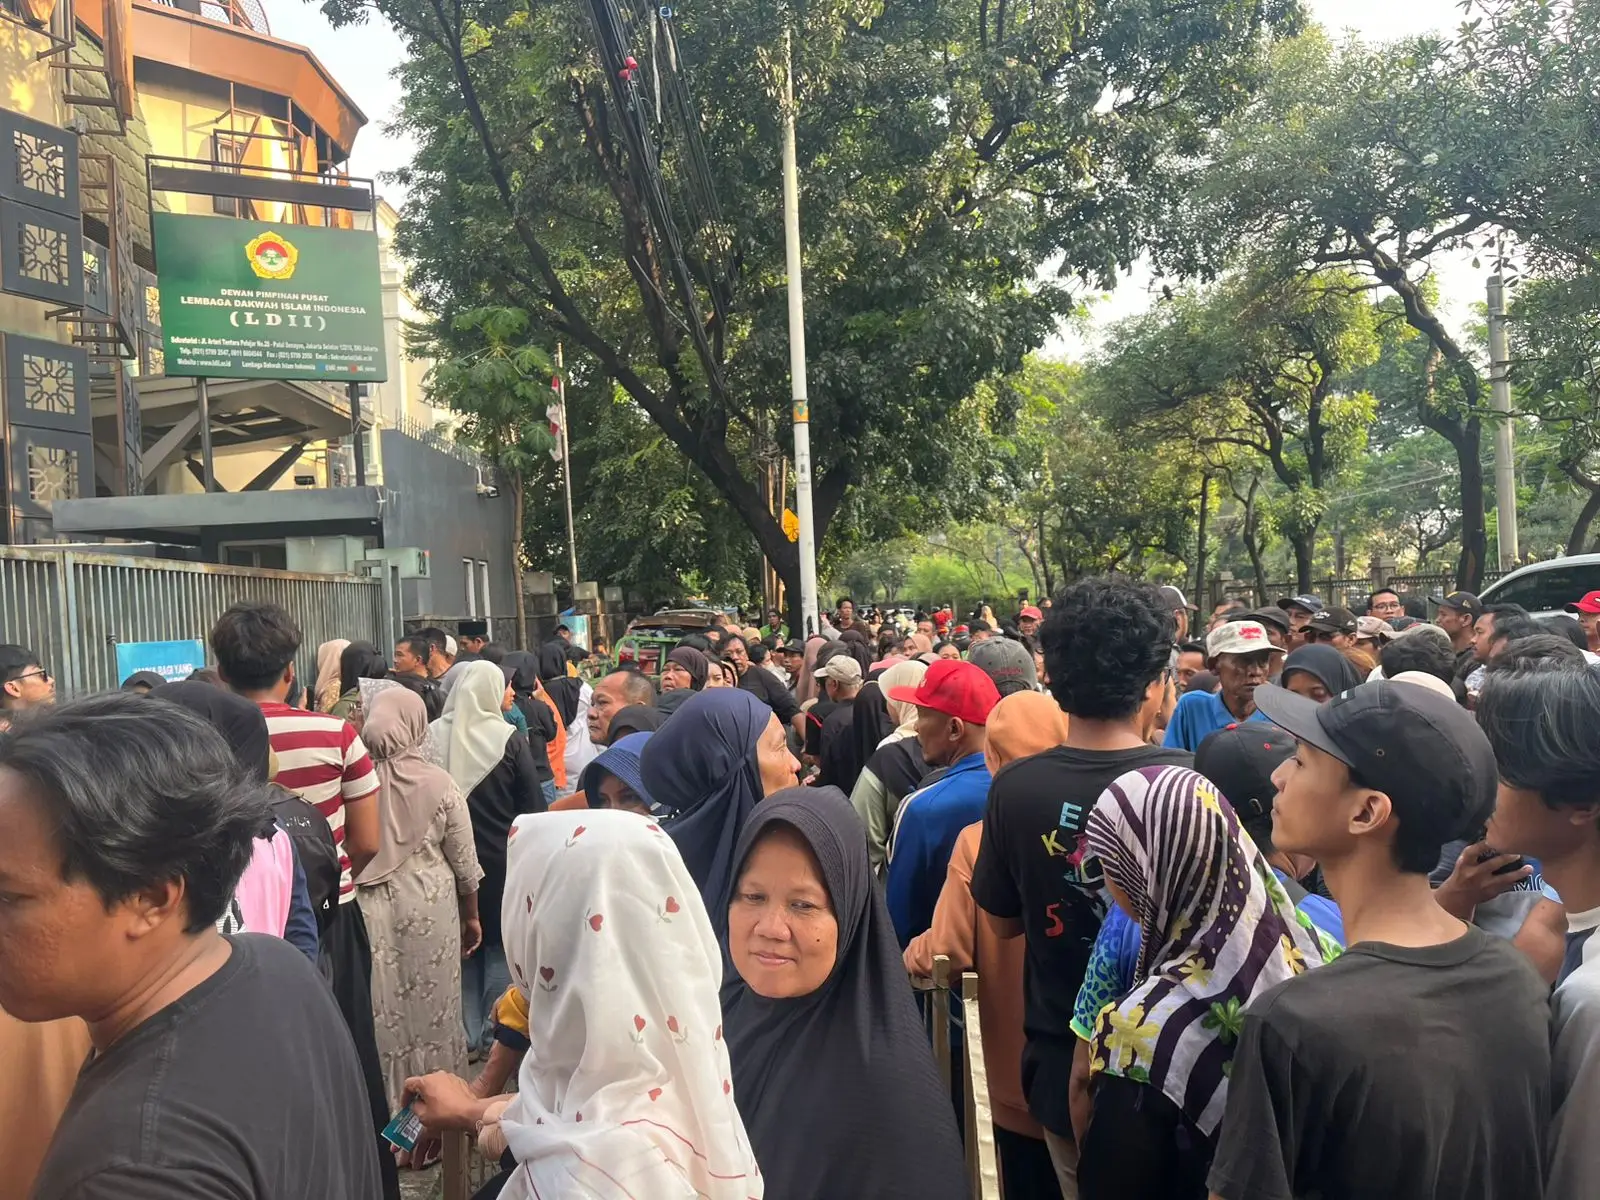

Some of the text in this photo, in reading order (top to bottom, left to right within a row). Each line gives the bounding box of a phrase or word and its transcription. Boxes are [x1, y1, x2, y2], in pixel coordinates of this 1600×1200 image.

[221, 288, 328, 302] DEWAN PIMPINAN PUSAT
[180, 296, 366, 314] LEMBAGA DAKWAH ISLAM INDONESIA
